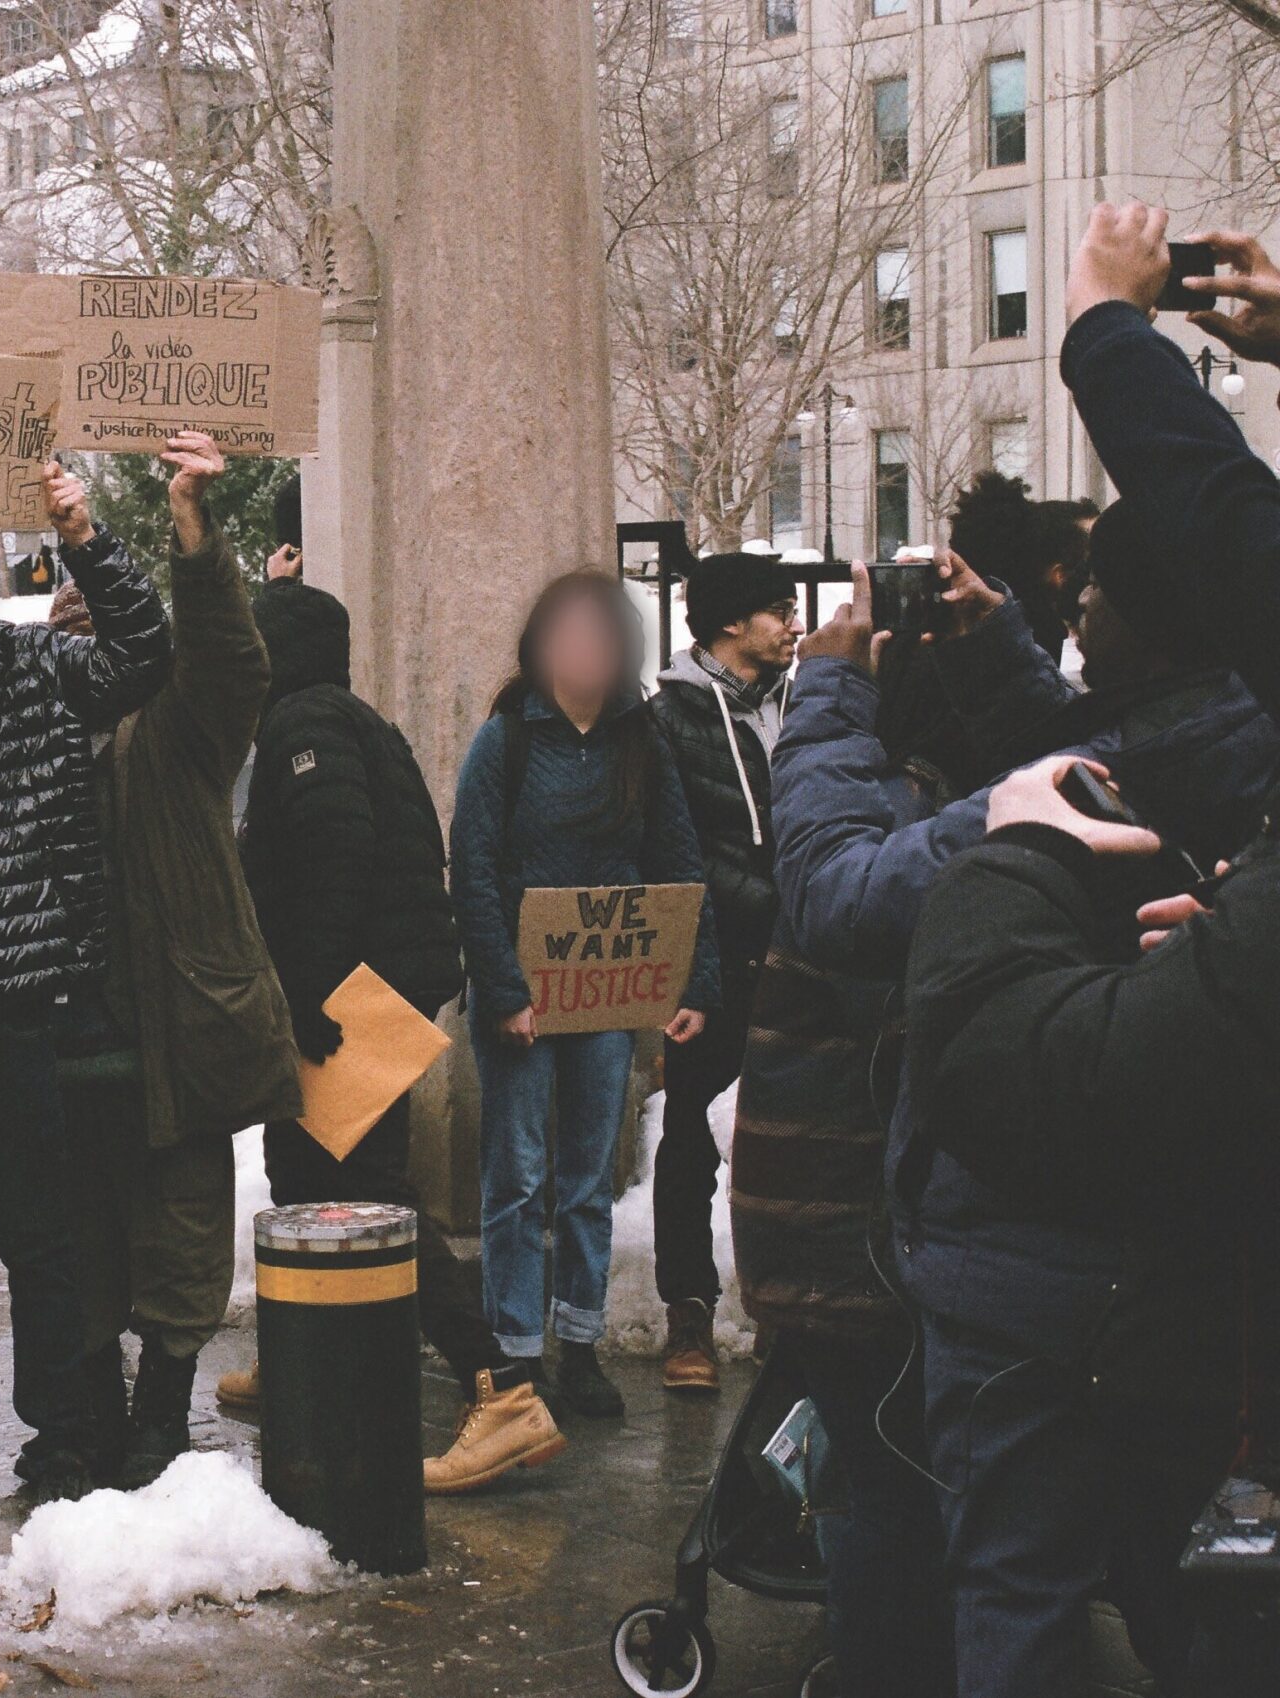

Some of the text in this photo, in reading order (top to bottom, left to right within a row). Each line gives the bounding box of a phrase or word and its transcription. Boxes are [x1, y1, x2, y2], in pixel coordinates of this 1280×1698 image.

[79, 279, 258, 320] RENDEZ
[105, 331, 193, 360] la vidéo
[77, 360, 269, 408] PUBLIQUE
[576, 886, 647, 930] WE
[545, 930, 658, 961] WANT
[530, 962, 673, 1017] JUSTICE
